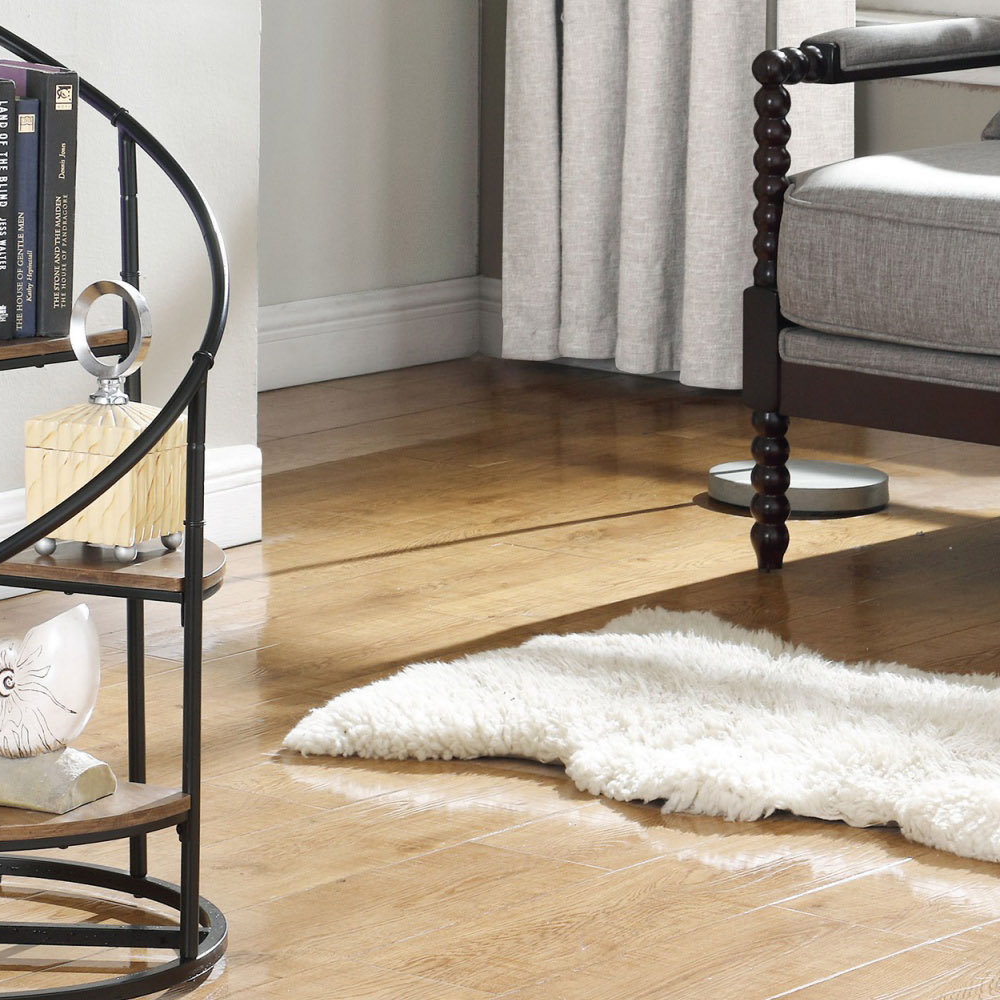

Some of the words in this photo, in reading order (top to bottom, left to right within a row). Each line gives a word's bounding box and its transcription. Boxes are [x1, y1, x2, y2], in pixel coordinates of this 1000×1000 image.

[0, 217, 7, 236] JESS
[17, 212, 25, 232] MEN
[61, 194, 69, 247] PANDRAGORE
[0, 239, 7, 271] WALTER
[61, 250, 67, 261] OF
[17, 269, 24, 280] OF
[53, 265, 61, 291] STONE
[16, 281, 24, 312] HOUSE
[26, 282, 34, 302] Kathy
[15, 314, 23, 332] THE
